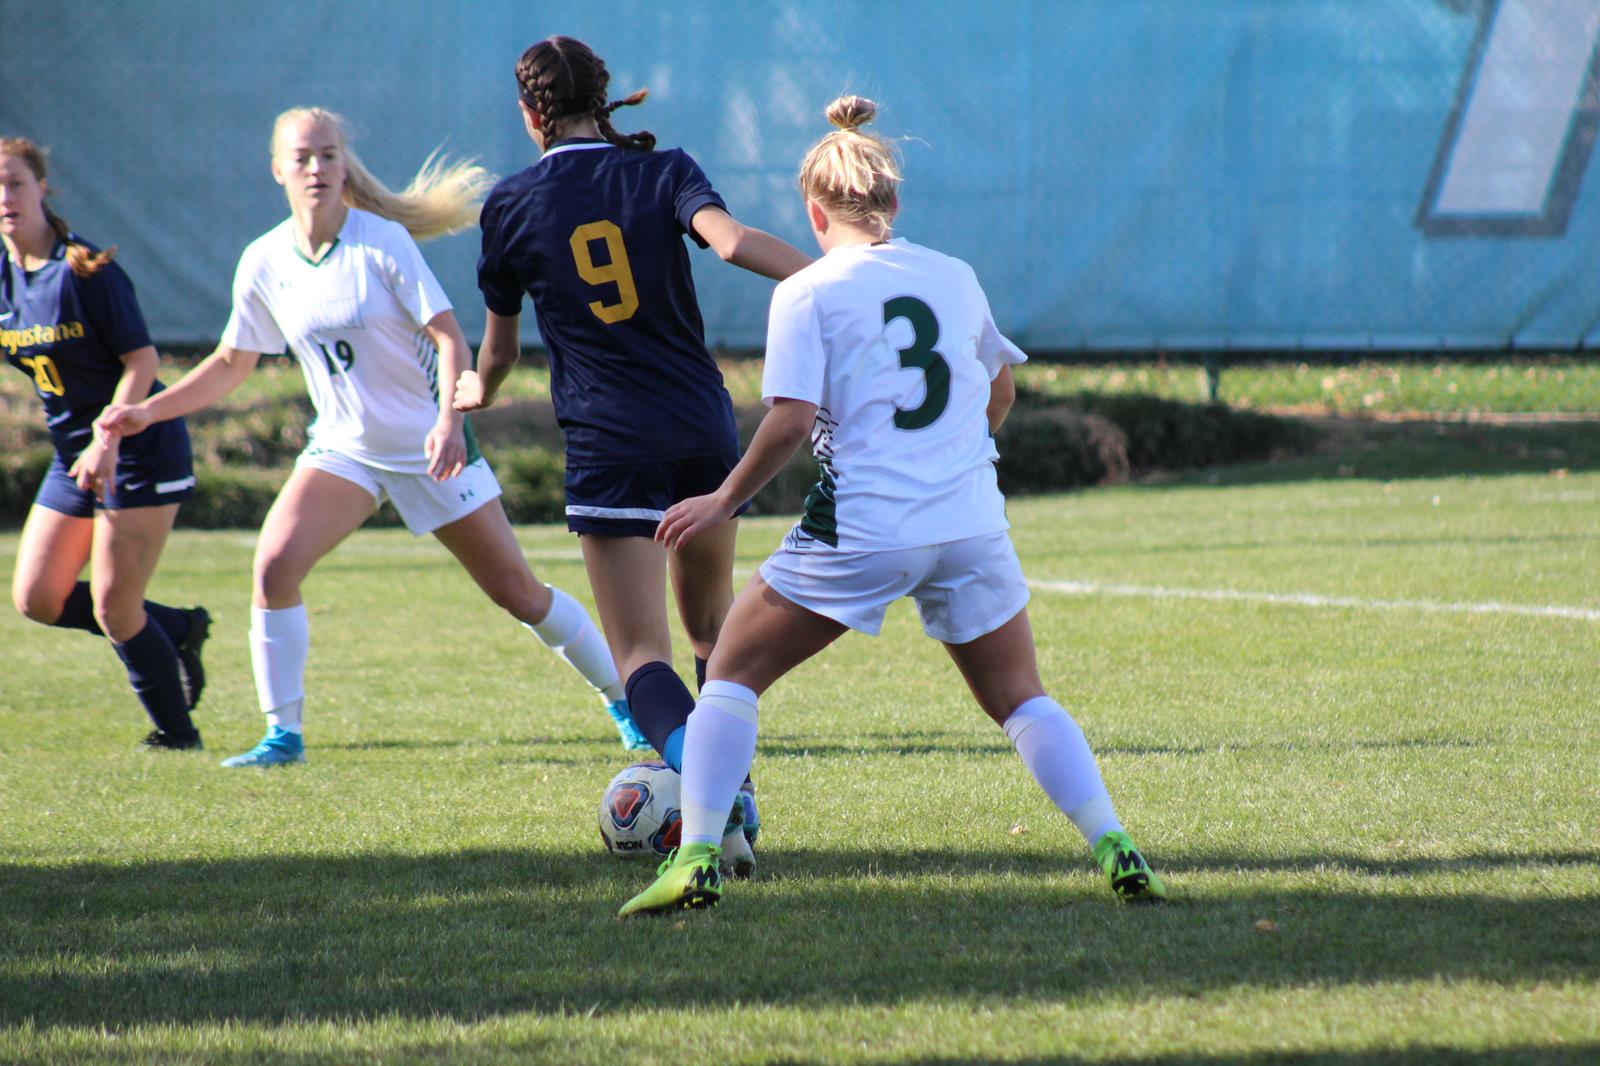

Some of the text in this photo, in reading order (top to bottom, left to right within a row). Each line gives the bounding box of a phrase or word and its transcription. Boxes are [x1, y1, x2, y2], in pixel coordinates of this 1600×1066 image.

[569, 219, 640, 325] 9
[0, 320, 85, 355] ugustana
[318, 339, 355, 376] 19
[880, 294, 951, 432] 3
